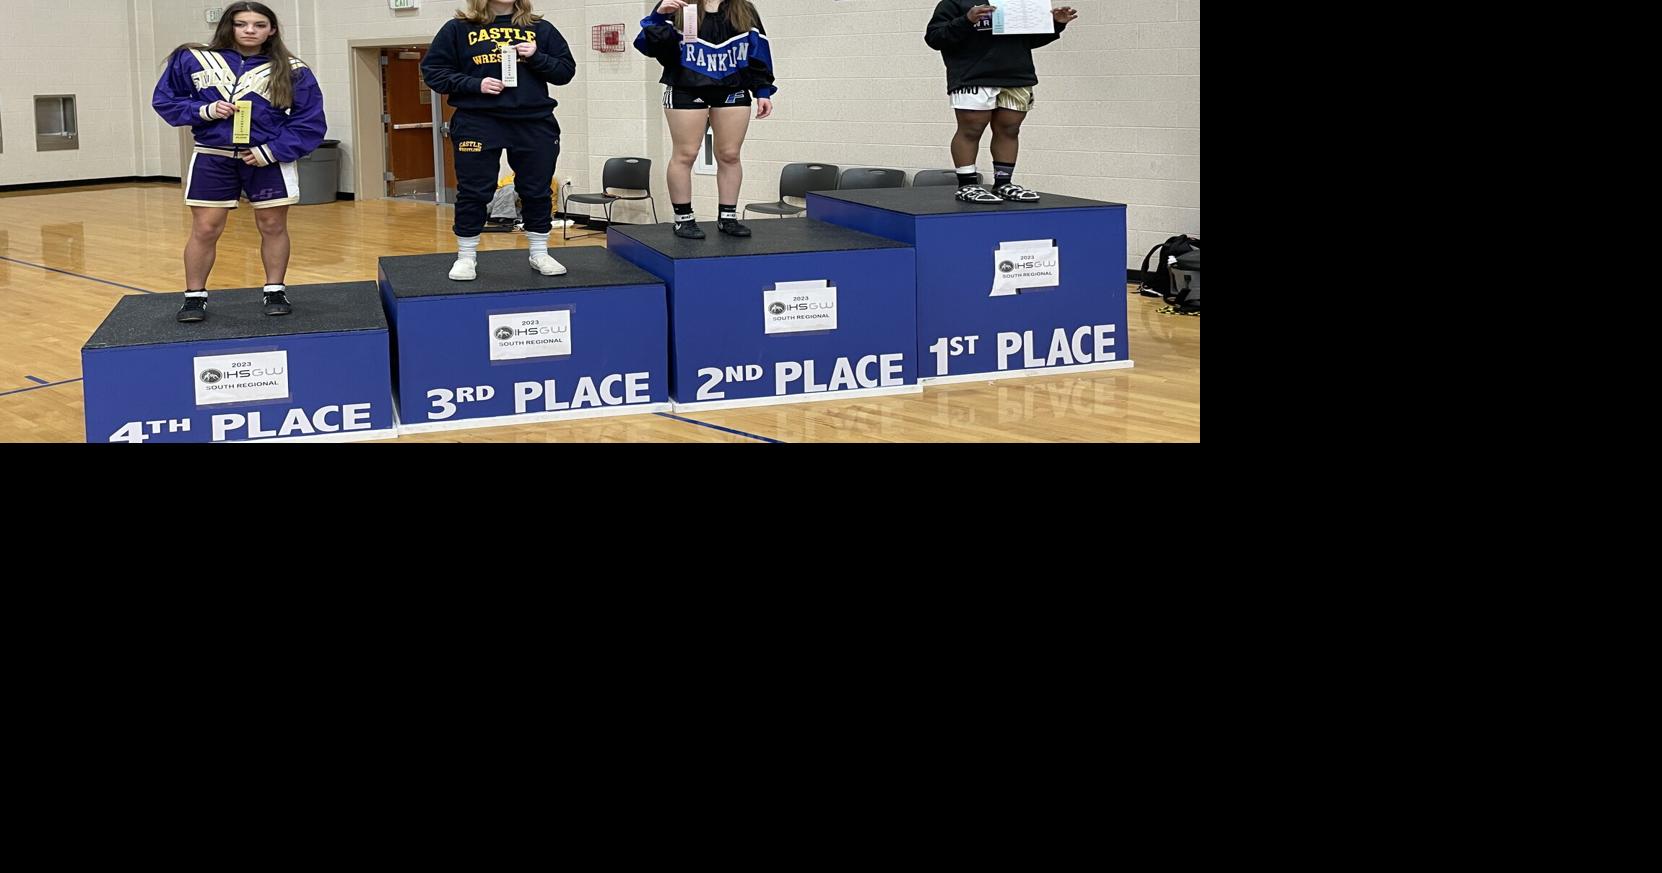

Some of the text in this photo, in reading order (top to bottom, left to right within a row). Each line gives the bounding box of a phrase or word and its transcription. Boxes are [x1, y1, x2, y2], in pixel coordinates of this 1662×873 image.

[468, 27, 536, 45] CASTLE
[680, 42, 749, 72] RANKLIN
[458, 140, 482, 148] CASTLE
[1014, 260, 1056, 270] IHSGW
[786, 301, 834, 311] IHSGW
[514, 325, 568, 336] IHSGW
[929, 323, 1116, 376] 1ST PLACE
[223, 366, 284, 379] IHSGW
[696, 353, 904, 401] 2ND PLACE
[205, 380, 279, 391] SOUTH REGIONAL
[426, 371, 651, 420] 3RD PLACE
[109, 403, 372, 442] 4TH PLACE
